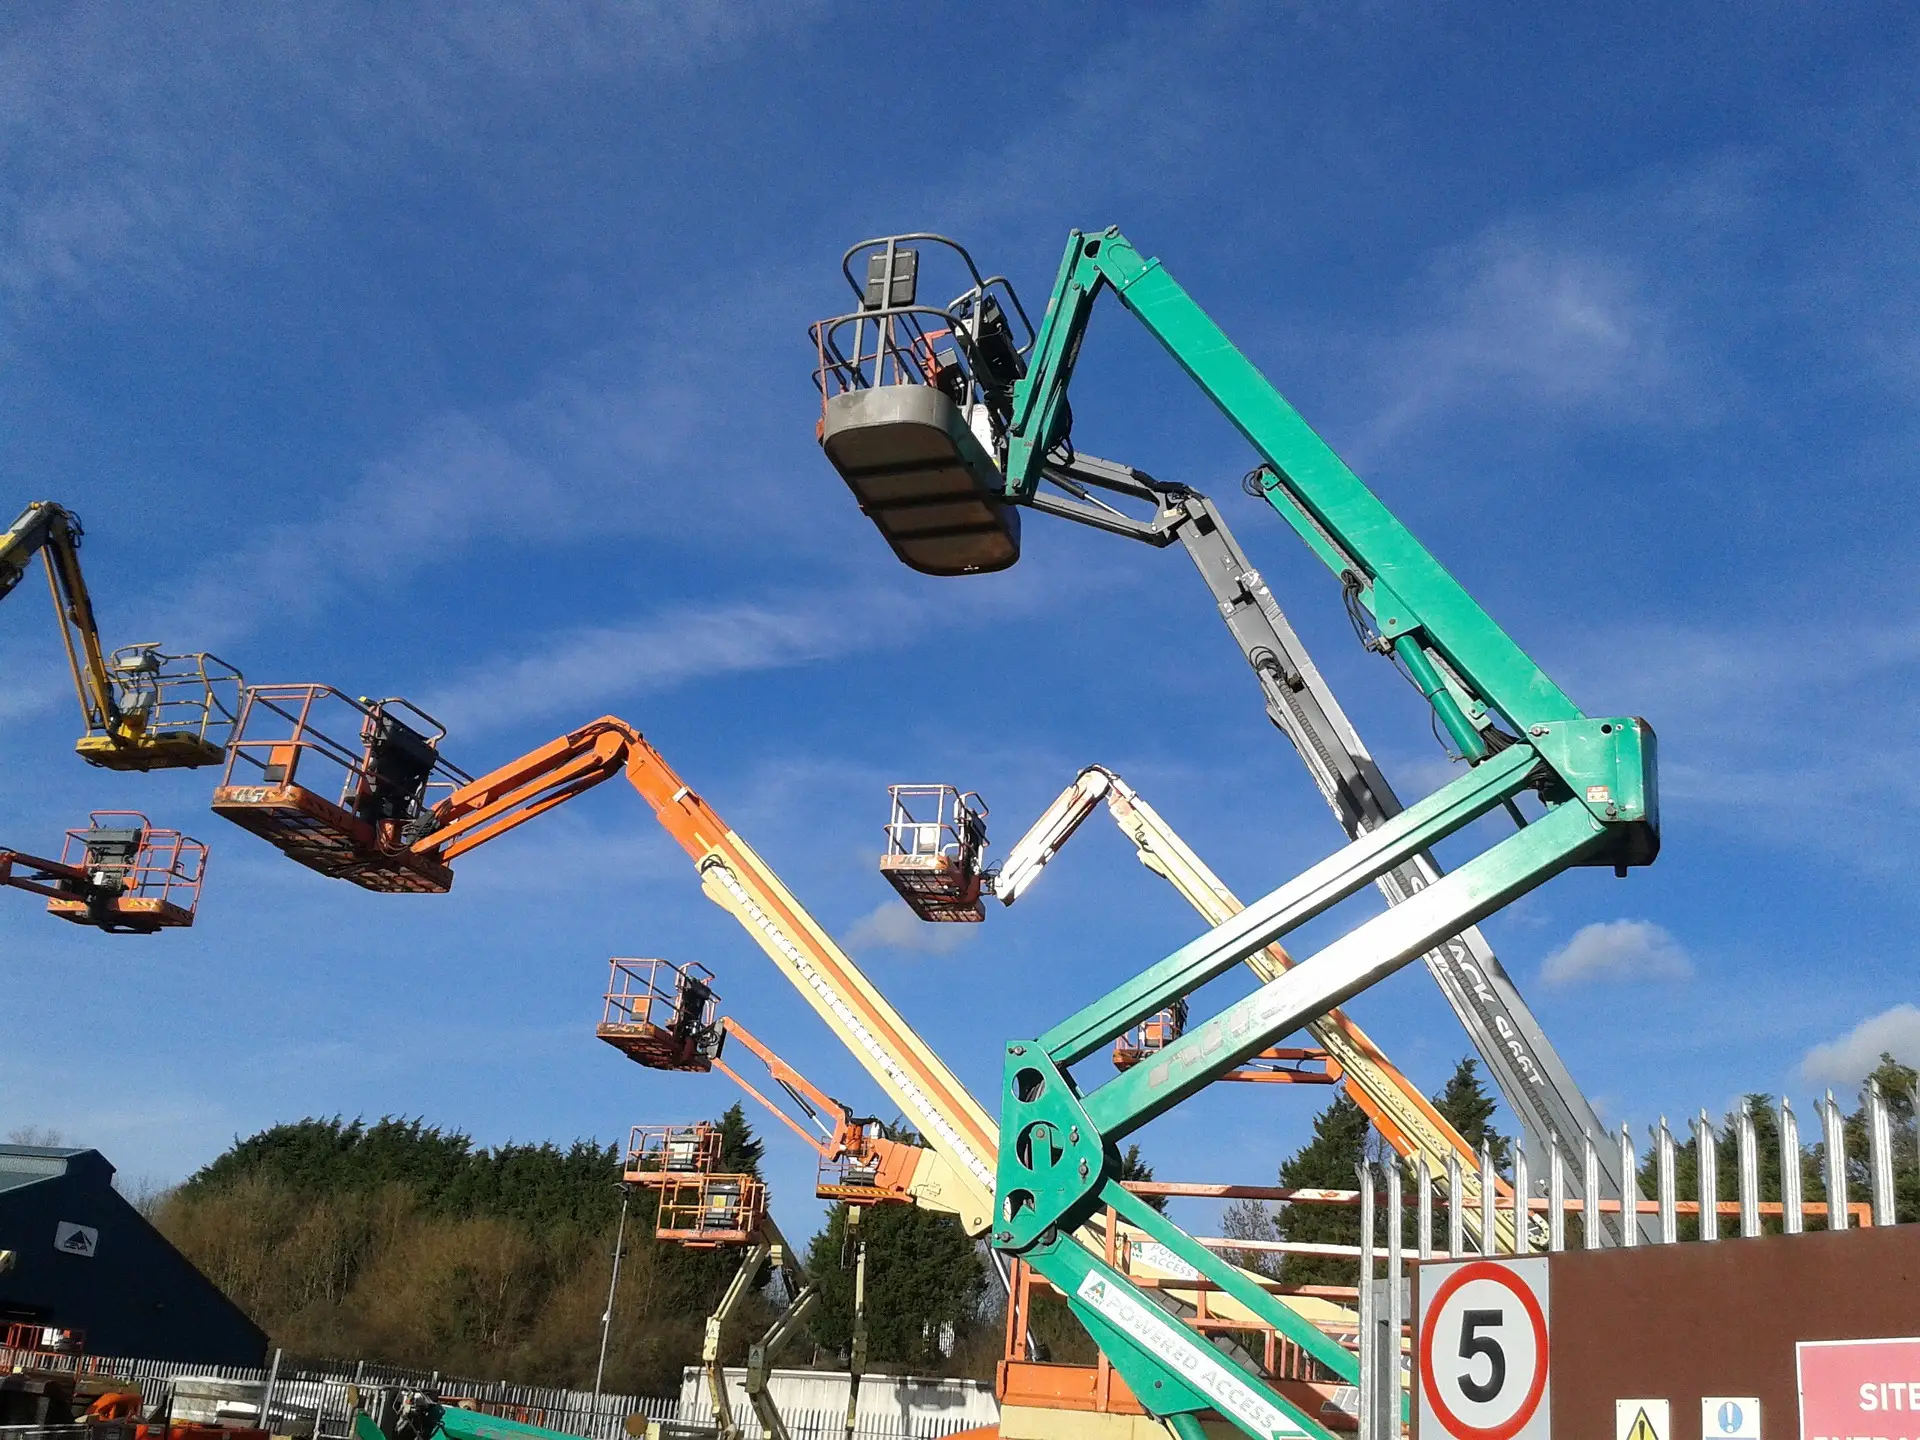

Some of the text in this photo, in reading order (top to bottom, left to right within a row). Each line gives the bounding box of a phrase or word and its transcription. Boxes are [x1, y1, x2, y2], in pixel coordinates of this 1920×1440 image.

[1149, 1254, 1194, 1277] ACCESS
[1084, 1290, 1105, 1306] PLANT
[1106, 1296, 1199, 1370] POWERED
[1201, 1370, 1276, 1429] ACCESS
[1457, 1309, 1506, 1403] 5
[1859, 1382, 1920, 1411] SITE
